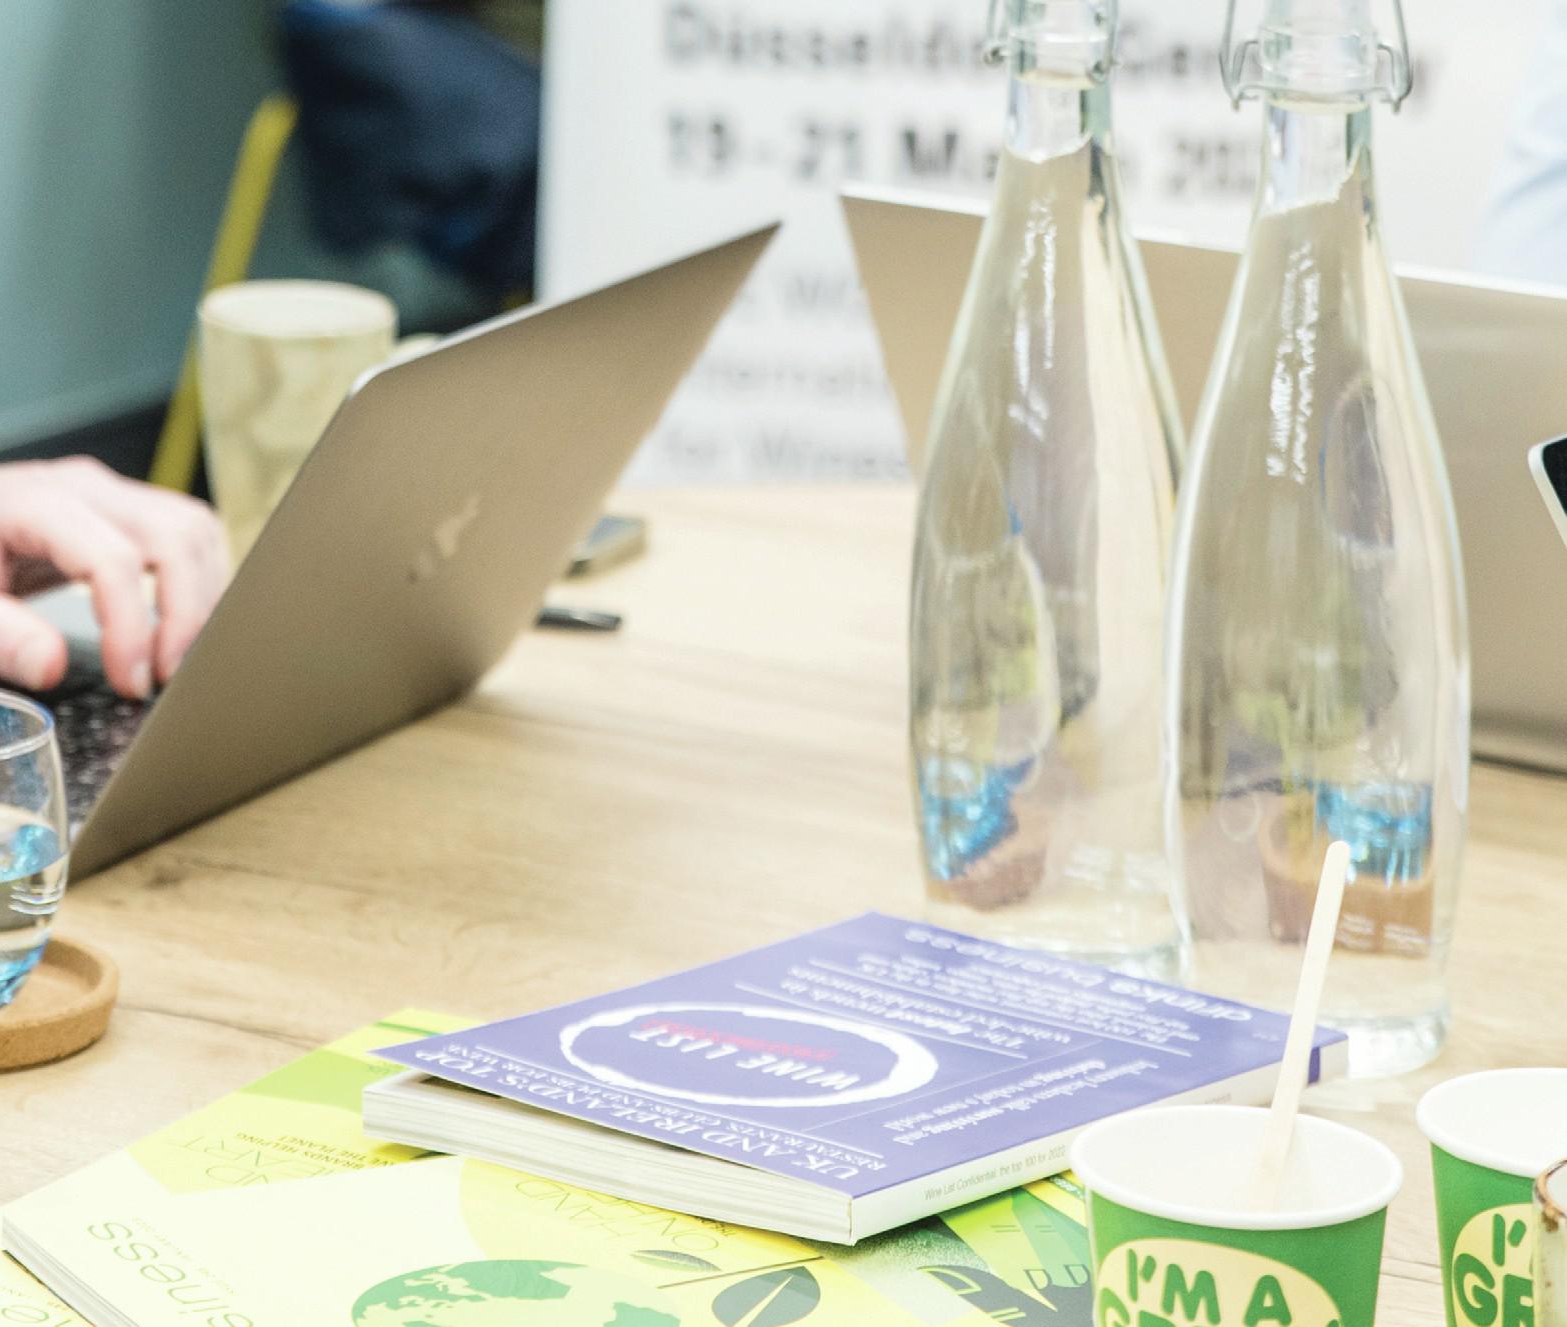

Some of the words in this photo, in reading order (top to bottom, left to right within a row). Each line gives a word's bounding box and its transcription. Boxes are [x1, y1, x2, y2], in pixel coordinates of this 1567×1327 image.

[666, 104, 737, 179] 19
[788, 109, 865, 185] 21
[629, 1026, 739, 1060] LIST
[415, 1052, 497, 1078] TOP
[736, 1055, 861, 1090] WINE
[497, 1074, 700, 1134] IRELAND'S
[702, 1132, 797, 1157] AND
[791, 1154, 859, 1179] UK
[1126, 1248, 1221, 1325] I'M
[1243, 1274, 1293, 1327] A
